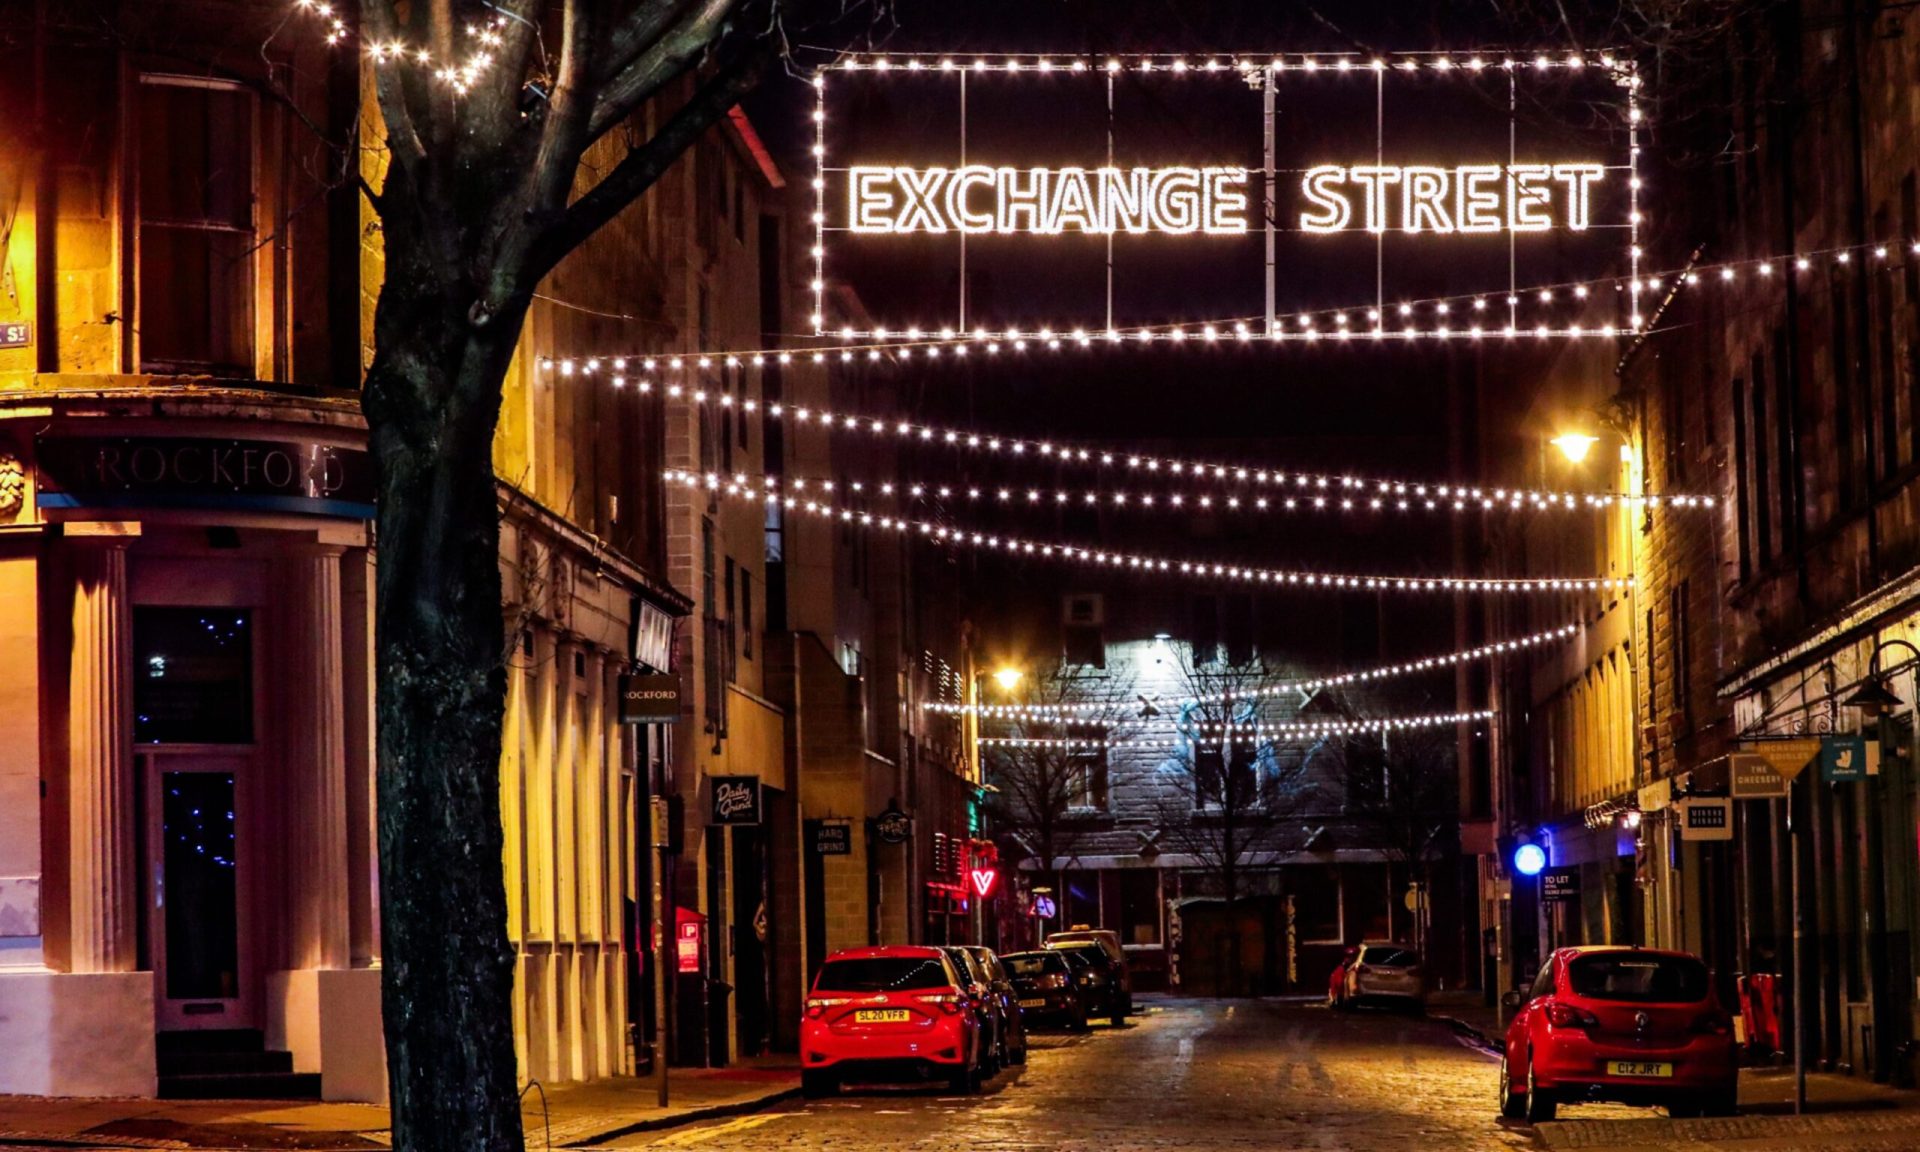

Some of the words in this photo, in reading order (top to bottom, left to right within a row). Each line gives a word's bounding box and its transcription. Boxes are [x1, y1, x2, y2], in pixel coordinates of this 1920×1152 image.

[848, 164, 1248, 236] EXCHANGE
[1301, 163, 1605, 235] STREET
[7, 326, 26, 342] ST
[99, 446, 344, 491] ROCKFORD
[624, 690, 677, 700] ROCKFORD
[1760, 743, 1818, 752] INCREDIBLE
[1770, 752, 1809, 760] EDIBLES
[1751, 765, 1767, 774] THE
[1737, 775, 1781, 784] CHEESERY
[717, 782, 750, 802] Daily
[720, 795, 753, 816] Grind
[818, 829, 844, 840] HARD
[817, 842, 845, 852] GRIND
[1544, 876, 1555, 884] TO
[1556, 875, 1569, 884] LET
[686, 926, 696, 937] P
[859, 1010, 885, 1021] SL20
[887, 1010, 905, 1020] VFR
[1617, 1063, 1637, 1074] C12
[1639, 1063, 1662, 1075] JRT
